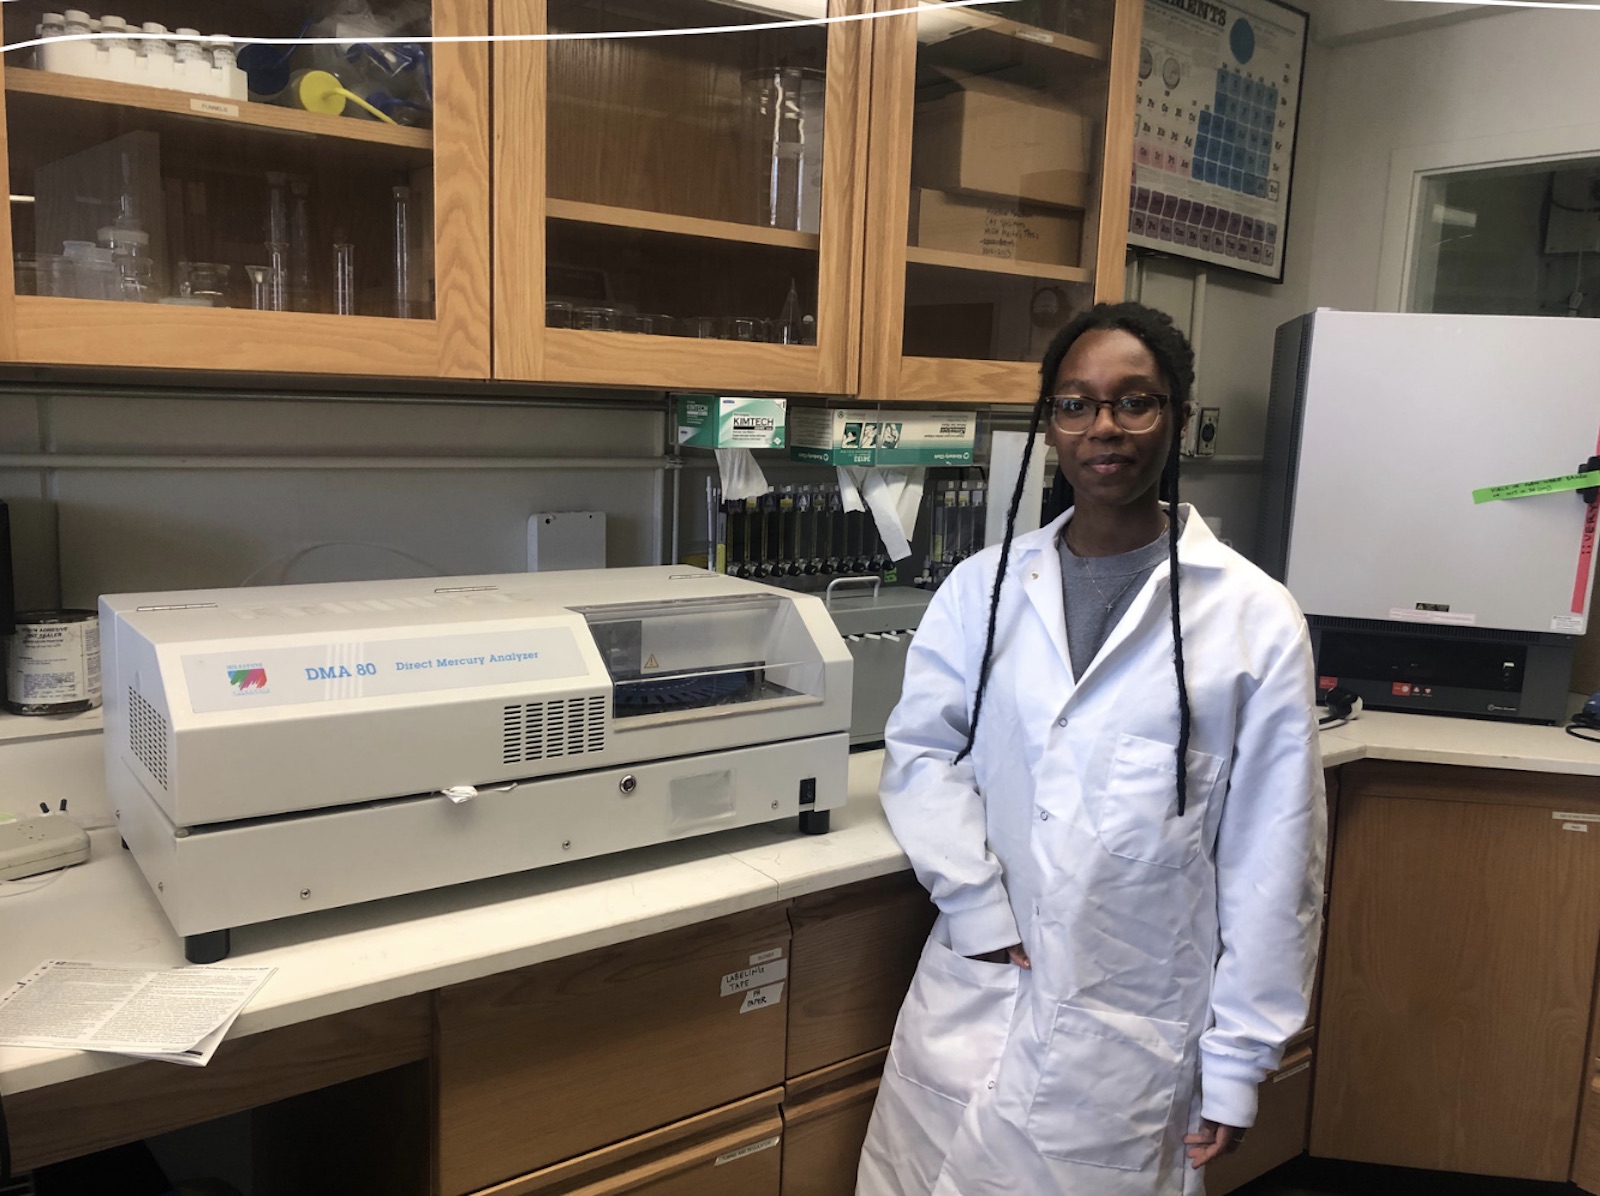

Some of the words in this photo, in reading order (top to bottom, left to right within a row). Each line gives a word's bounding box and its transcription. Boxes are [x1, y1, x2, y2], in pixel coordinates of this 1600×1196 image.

[733, 417, 774, 426] KIMTECH
[305, 666, 352, 682] DMA
[356, 662, 377, 677] 80
[395, 659, 433, 671] Direct
[436, 656, 486, 669] Mercury
[489, 650, 539, 664] Analyzer
[726, 965, 765, 983] LABELING
[729, 979, 749, 992] TAPE
